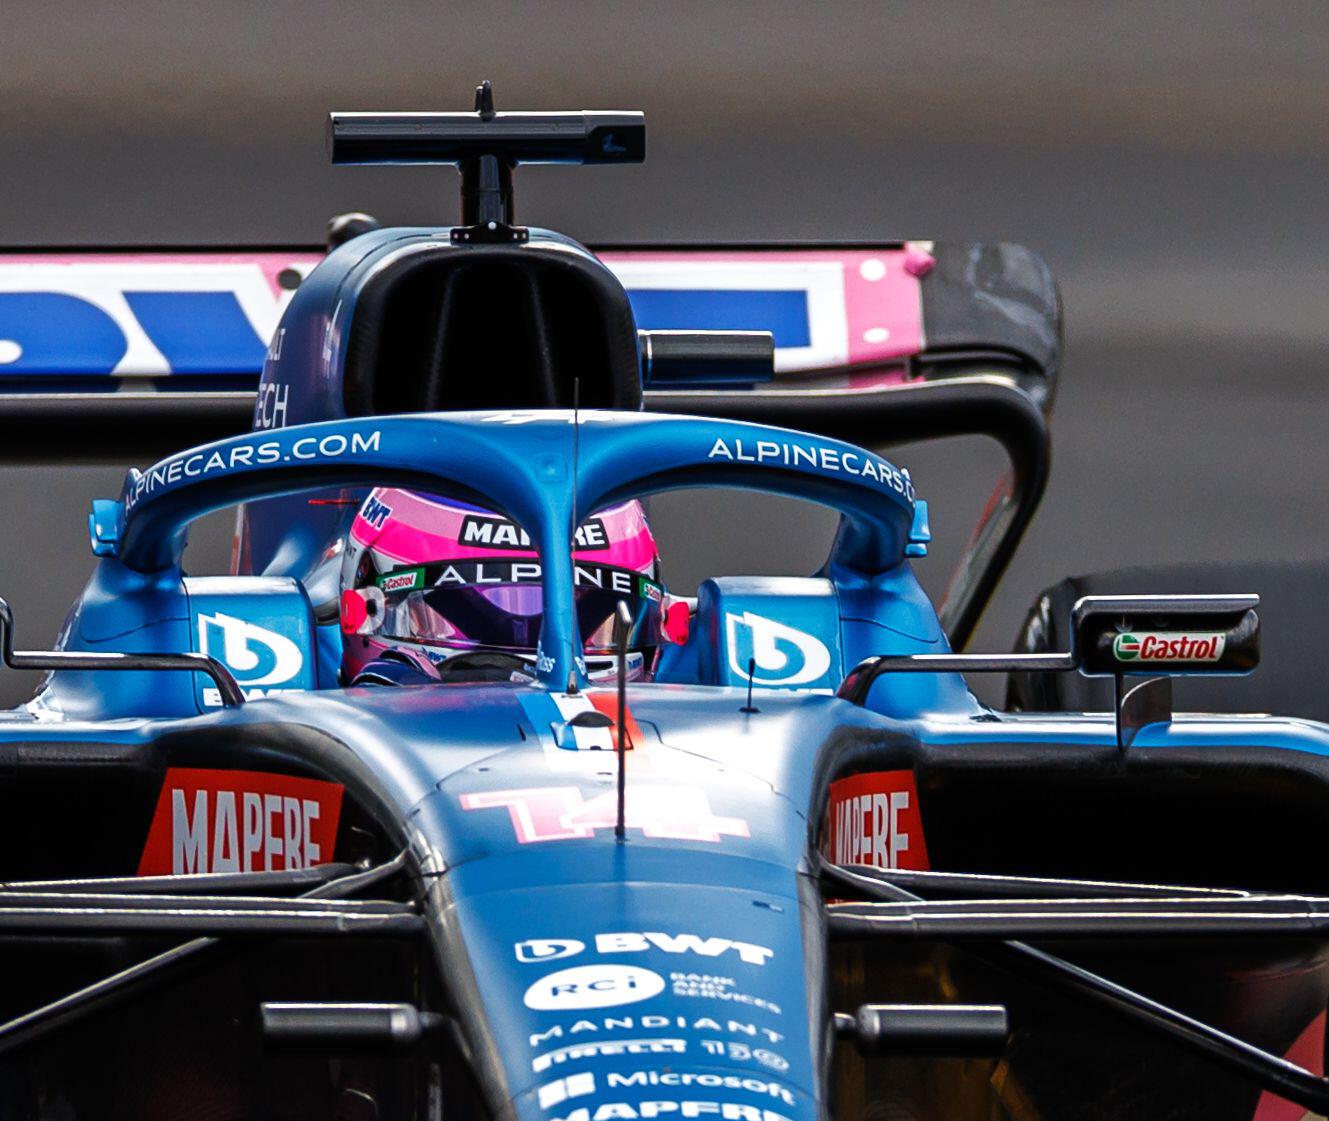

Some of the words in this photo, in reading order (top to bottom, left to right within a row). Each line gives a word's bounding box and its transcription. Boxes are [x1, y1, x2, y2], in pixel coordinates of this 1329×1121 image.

[125, 430, 381, 519] ALPINECARS.COM
[708, 437, 916, 508] ALPINECARS.C
[464, 521, 605, 546] MARE
[434, 563, 632, 594] ALPNE
[1140, 635, 1218, 660] Castrol
[172, 788, 321, 875] MAPFRE
[459, 785, 751, 844] 14
[595, 932, 774, 966] BWT
[529, 1015, 785, 1047] MANDIANT
[607, 1071, 796, 1107] Microsoft
